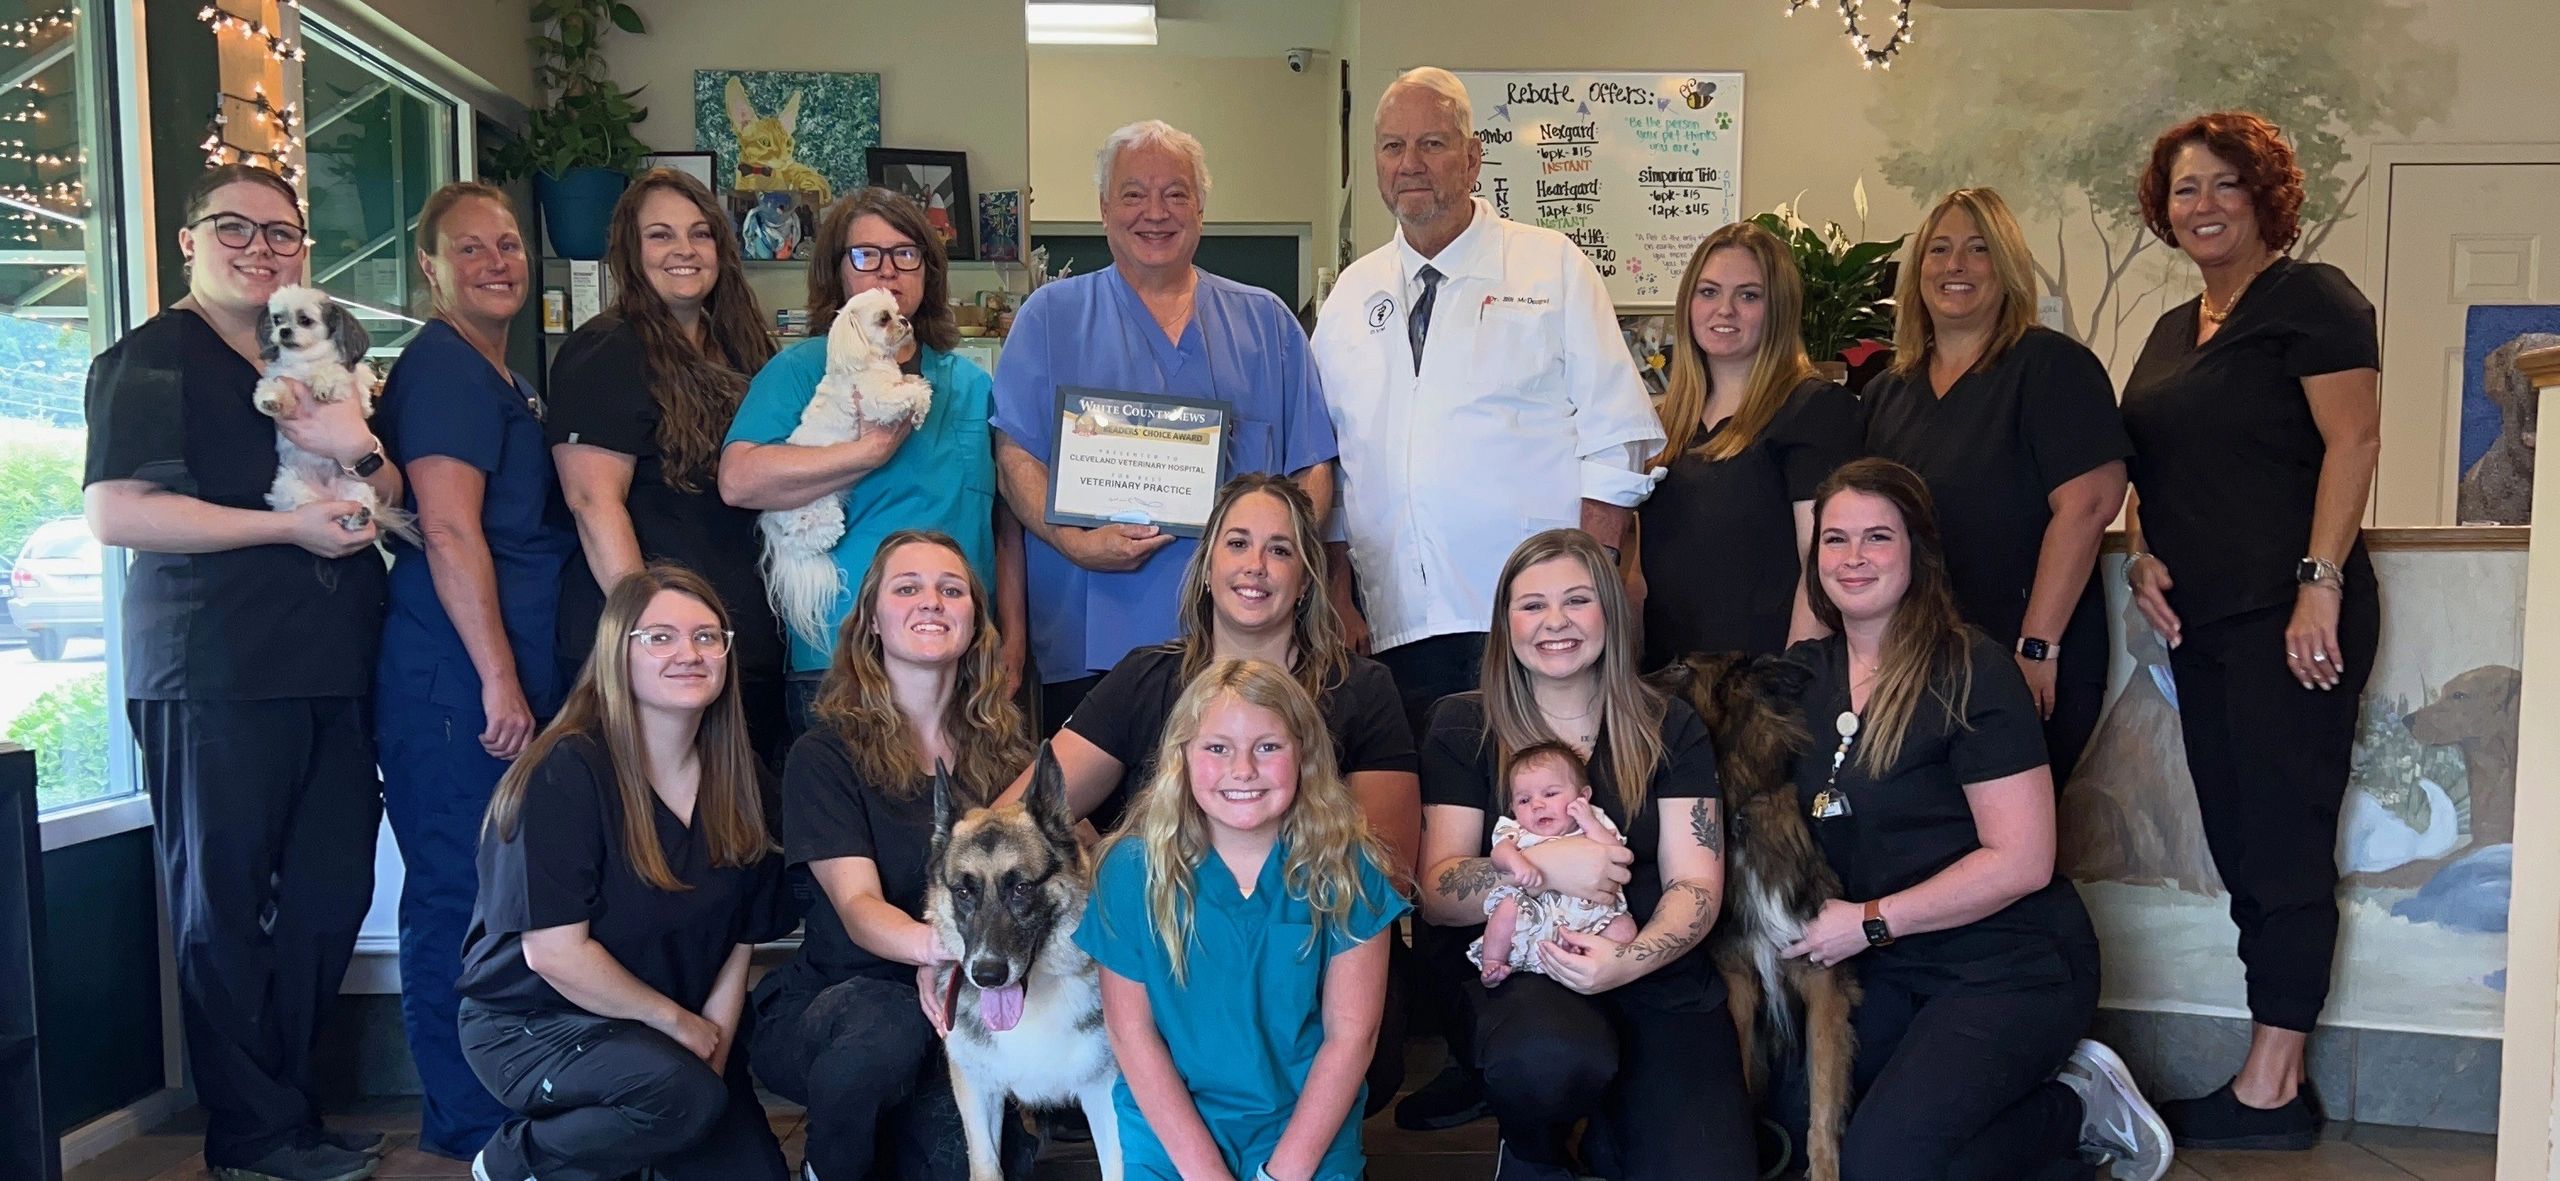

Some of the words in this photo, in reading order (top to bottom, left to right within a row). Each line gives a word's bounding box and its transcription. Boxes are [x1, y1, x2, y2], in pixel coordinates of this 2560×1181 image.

[1507, 82, 1575, 105] Rebate
[1589, 82, 1655, 105] Offers:
[1646, 116, 1661, 127] the
[1666, 119, 1700, 131] person
[1543, 160, 1593, 174] INSTANT
[1536, 217, 1588, 229] INSTANT
[1122, 404, 1171, 420] COUNTY
[1143, 429, 1172, 439] CHOICE
[1172, 431, 1203, 442] AWARD
[1070, 454, 1117, 465] CLEVELAND
[1118, 459, 1167, 470] VETERINARY
[1167, 464, 1206, 474] HOSPITAL
[1080, 477, 1141, 491] VETERINARY
[1143, 482, 1192, 496] PRACTICE
